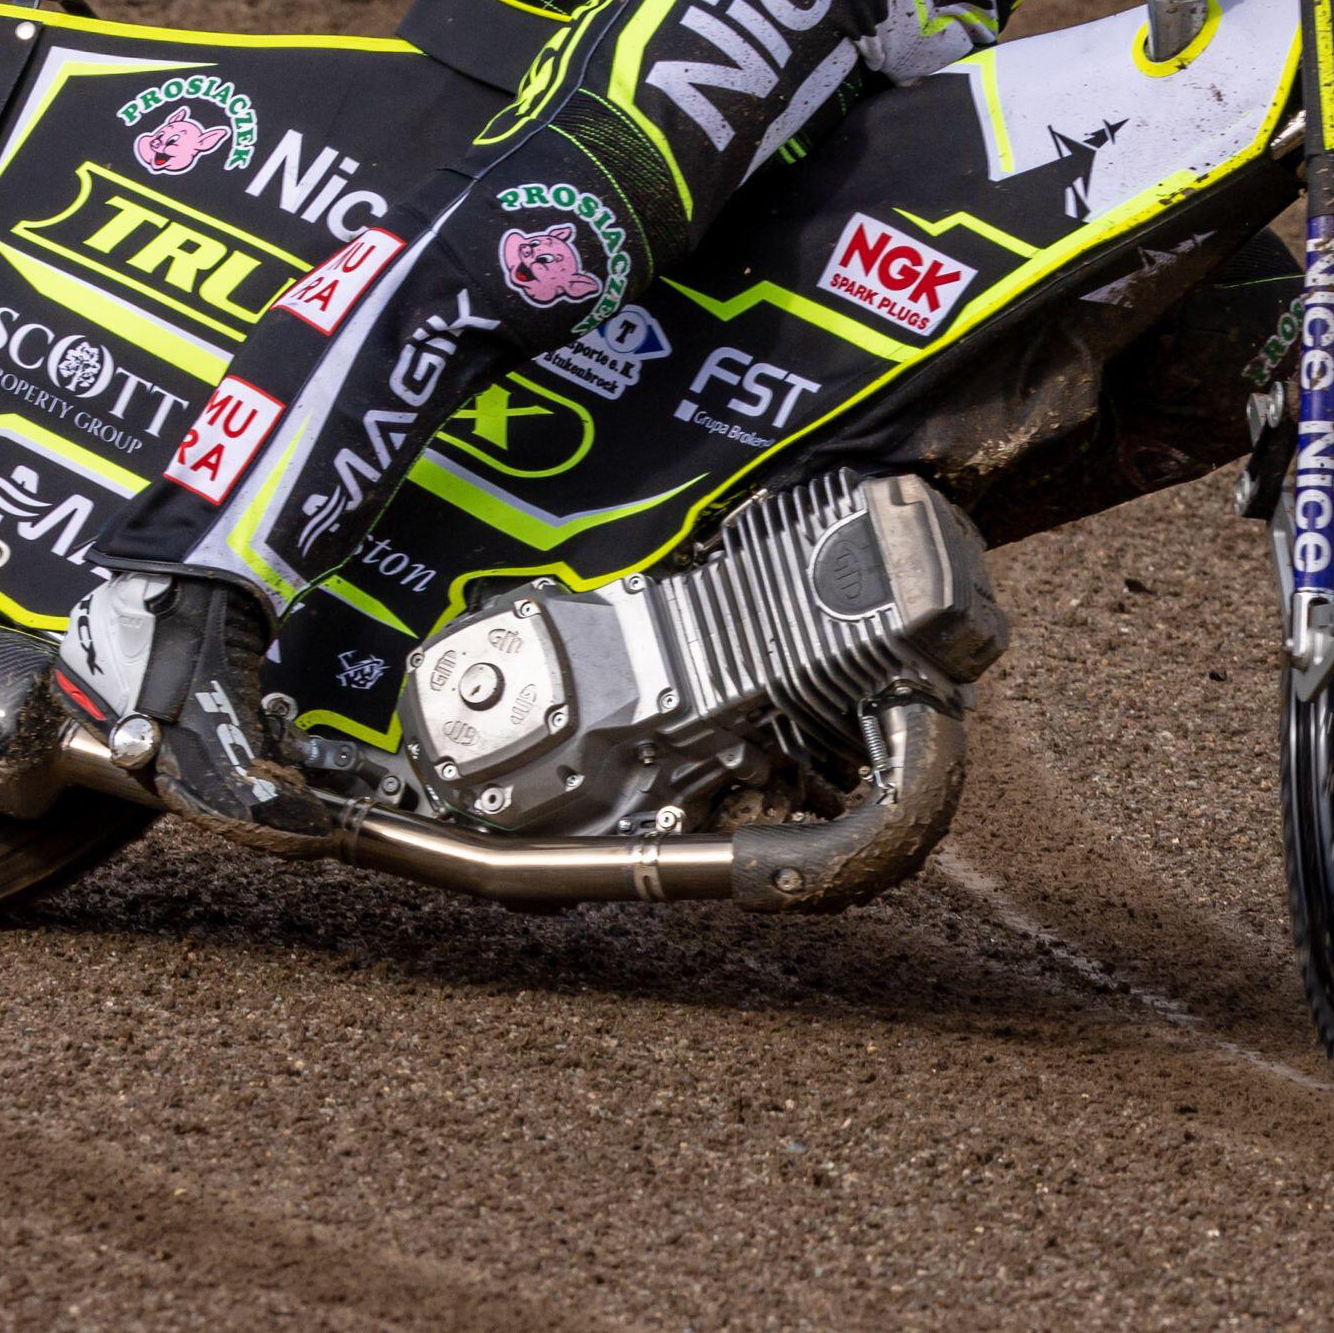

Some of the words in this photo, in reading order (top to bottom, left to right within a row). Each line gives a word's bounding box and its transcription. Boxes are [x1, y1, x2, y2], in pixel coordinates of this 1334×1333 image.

[118, 76, 256, 169] PROSIACZEK
[245, 128, 389, 243] Nic
[82, 194, 297, 324] TRU
[839, 222, 962, 313] NGK
[615, 319, 637, 344] T
[830, 273, 880, 306] SPARK
[878, 296, 931, 330] PLUGS
[689, 346, 822, 428] FST
[73, 411, 143, 454] GROUP
[177, 428, 226, 481] RA
[694, 410, 728, 435] Grupa
[357, 534, 437, 592] ton
[78, 594, 105, 677] TCX
